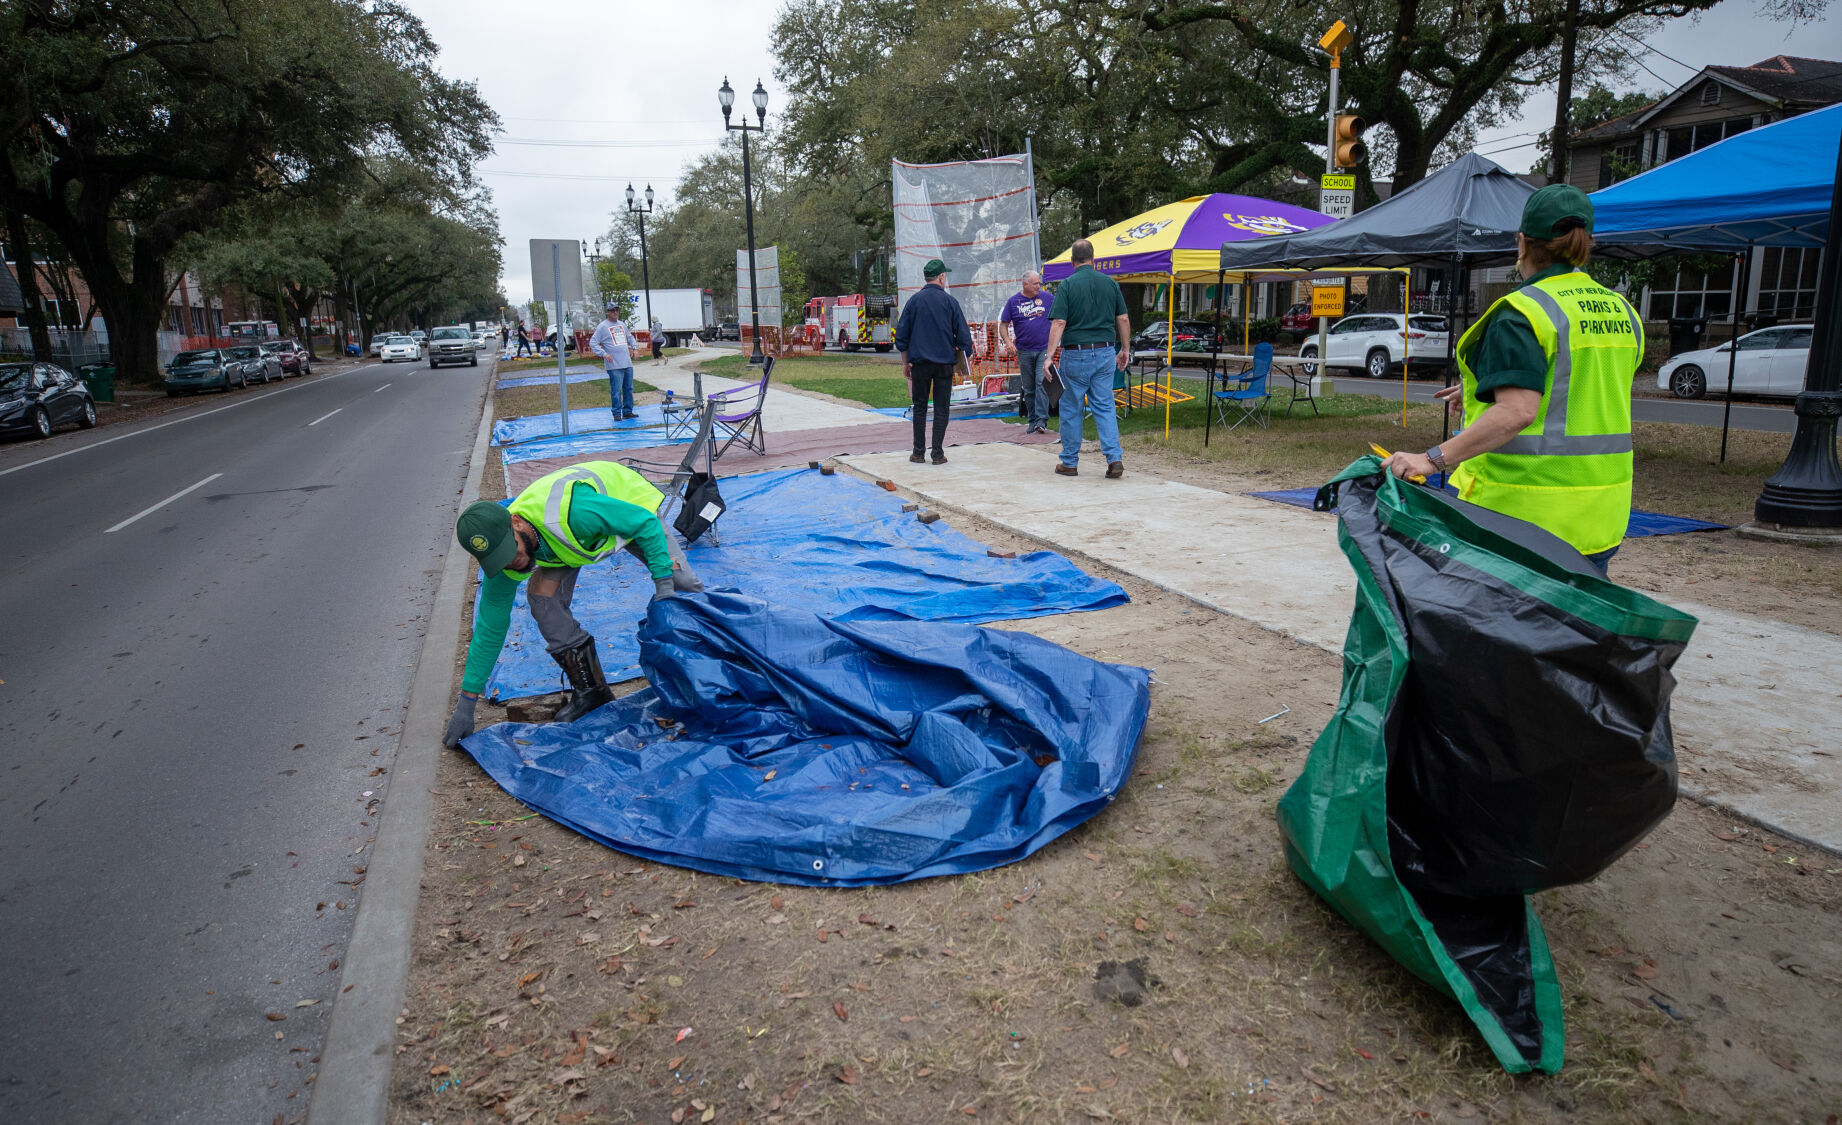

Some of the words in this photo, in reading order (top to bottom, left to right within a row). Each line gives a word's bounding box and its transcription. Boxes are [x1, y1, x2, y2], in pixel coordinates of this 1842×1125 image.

[1324, 178, 1352, 187] SCHOOL
[1323, 195, 1351, 204] SPEED
[1325, 206, 1347, 214] LIMIT
[1093, 259, 1121, 271] IGERS
[1557, 288, 1575, 297] CITY
[1575, 287, 1585, 295] OF
[1585, 287, 1598, 295] NEW
[1313, 303, 1342, 311] ENFORCED
[1577, 300, 1611, 313] PARKS
[1611, 301, 1622, 313] &
